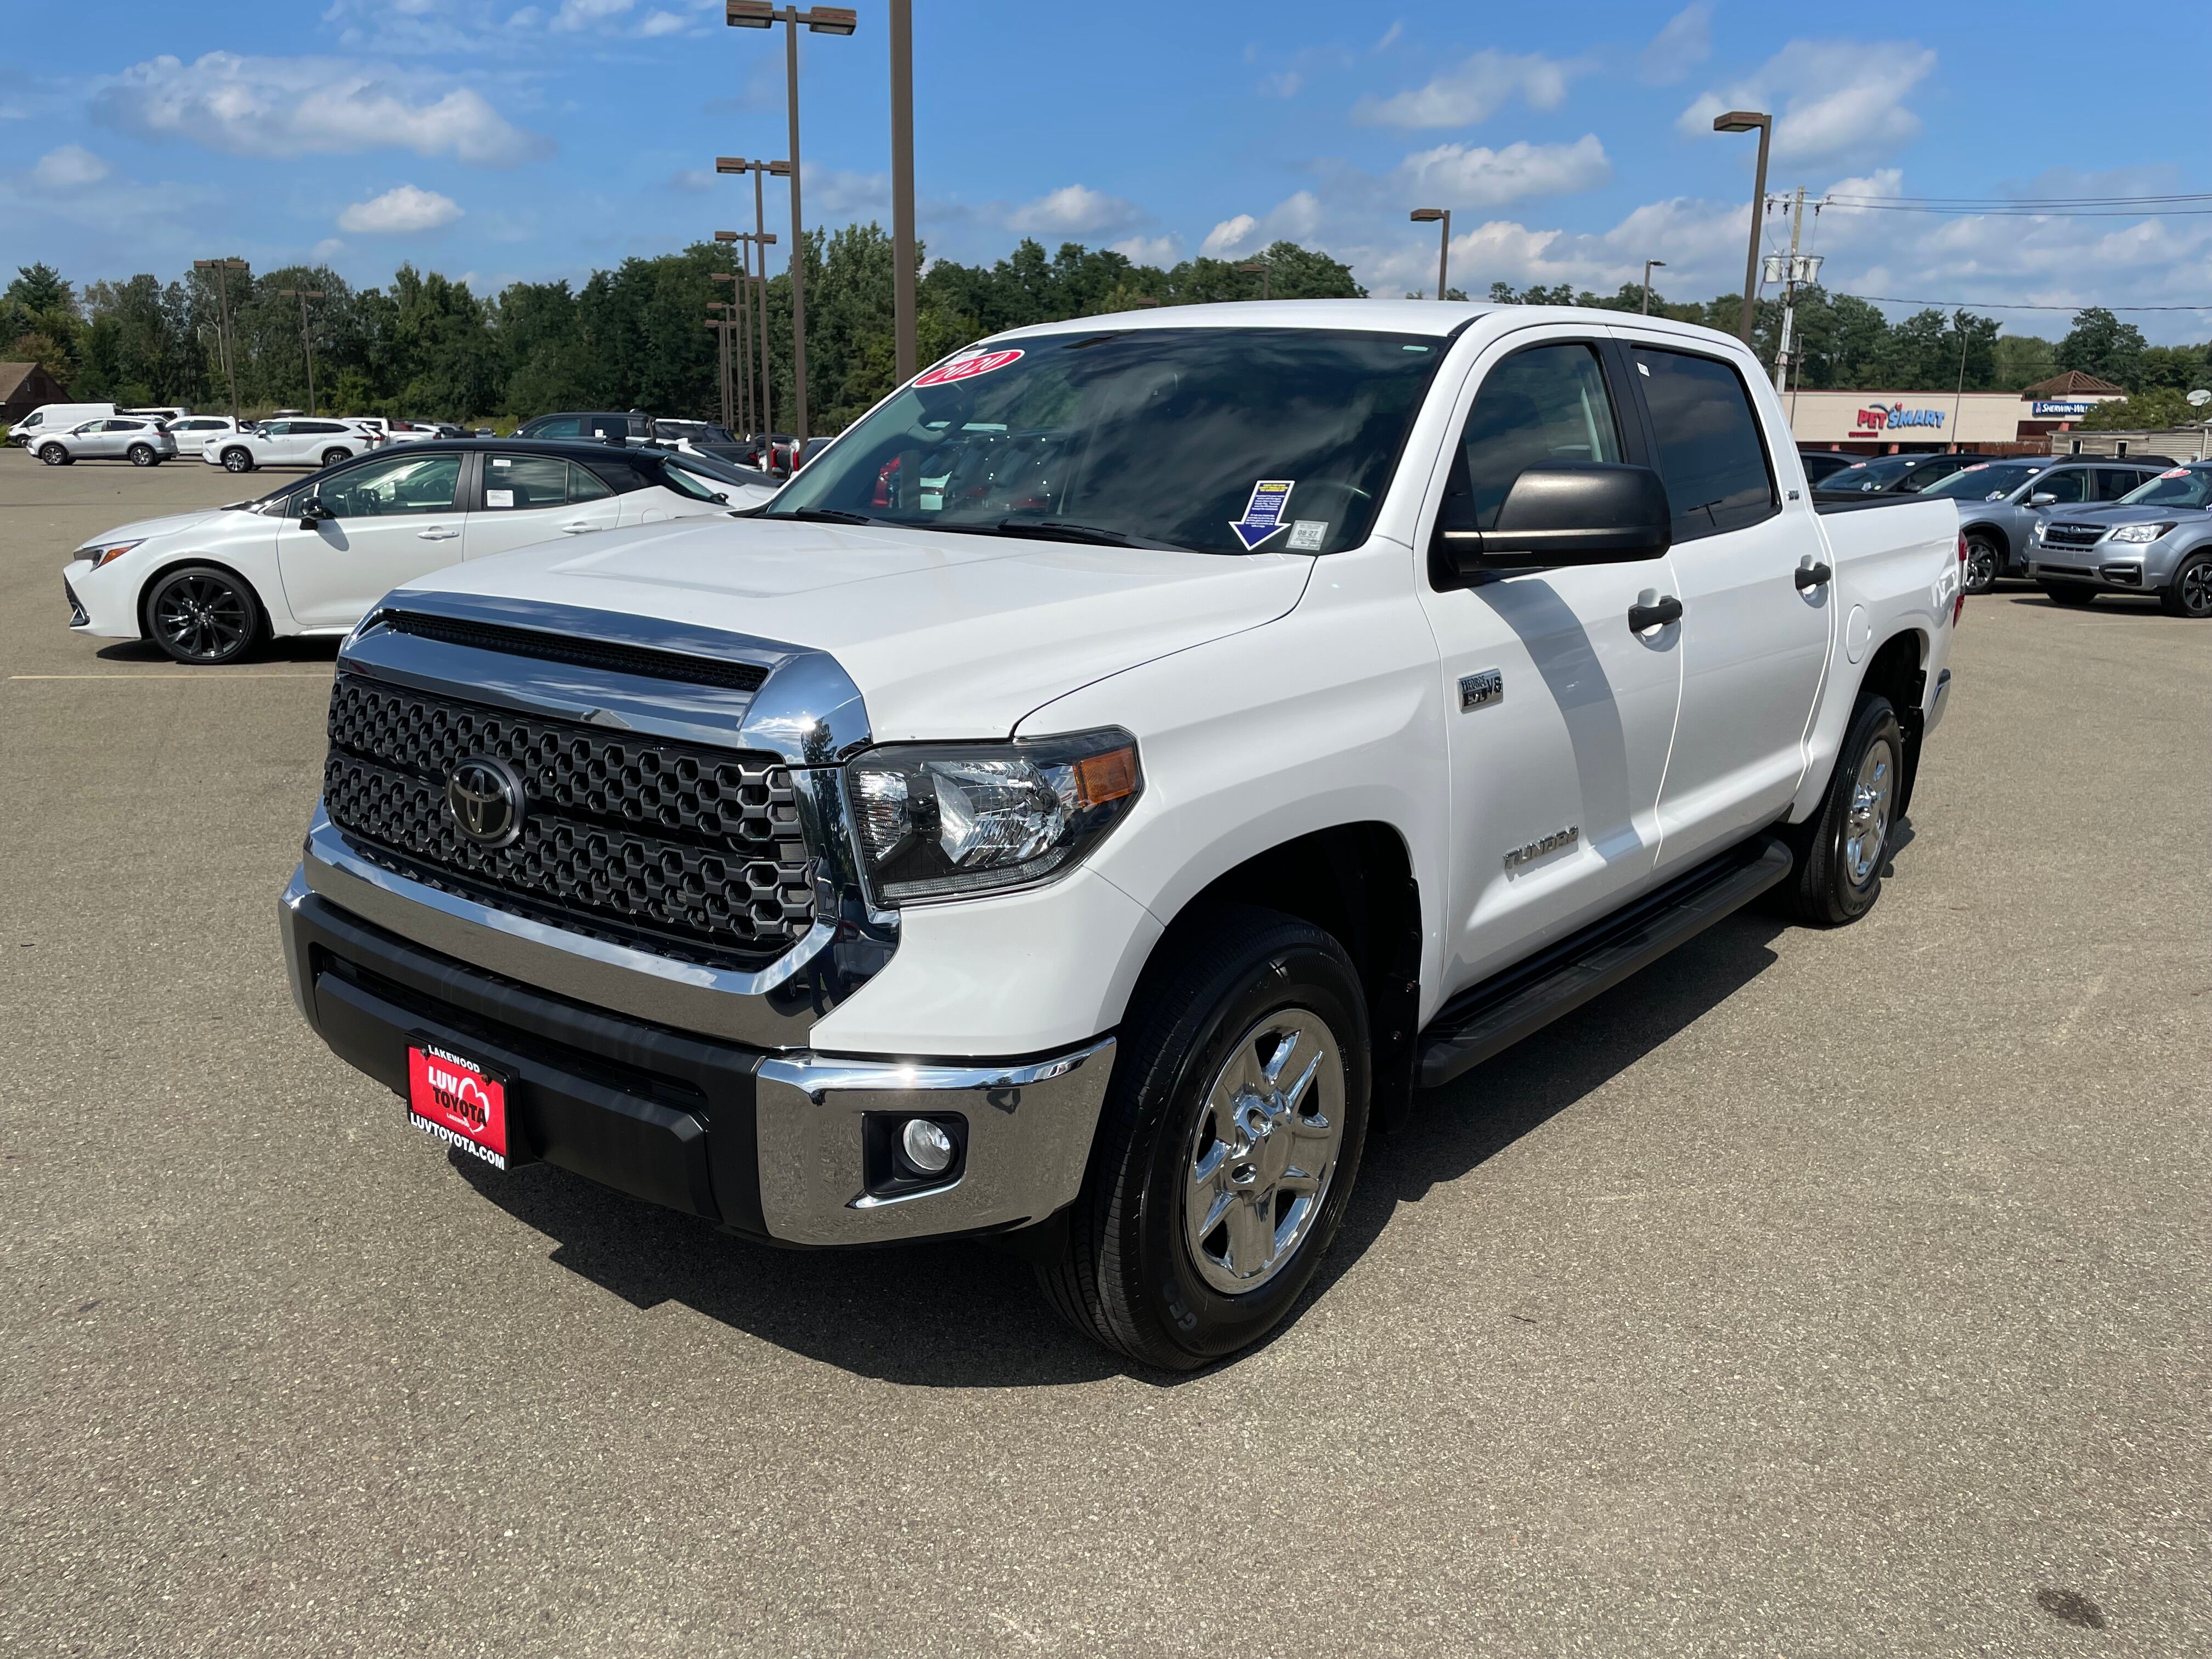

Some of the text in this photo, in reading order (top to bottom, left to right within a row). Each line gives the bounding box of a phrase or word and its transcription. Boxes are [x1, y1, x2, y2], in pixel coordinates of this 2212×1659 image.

[922, 352, 1012, 384] 2020
[1857, 408, 1945, 431] PETSMART
[1504, 825, 1579, 870] TUNDRA
[428, 1045, 480, 1073] LAKEWOOD
[428, 1065, 458, 1094] LUV
[433, 1086, 488, 1127] TOYOTA
[410, 1112, 505, 1171] LUVTOYOTA.COM
